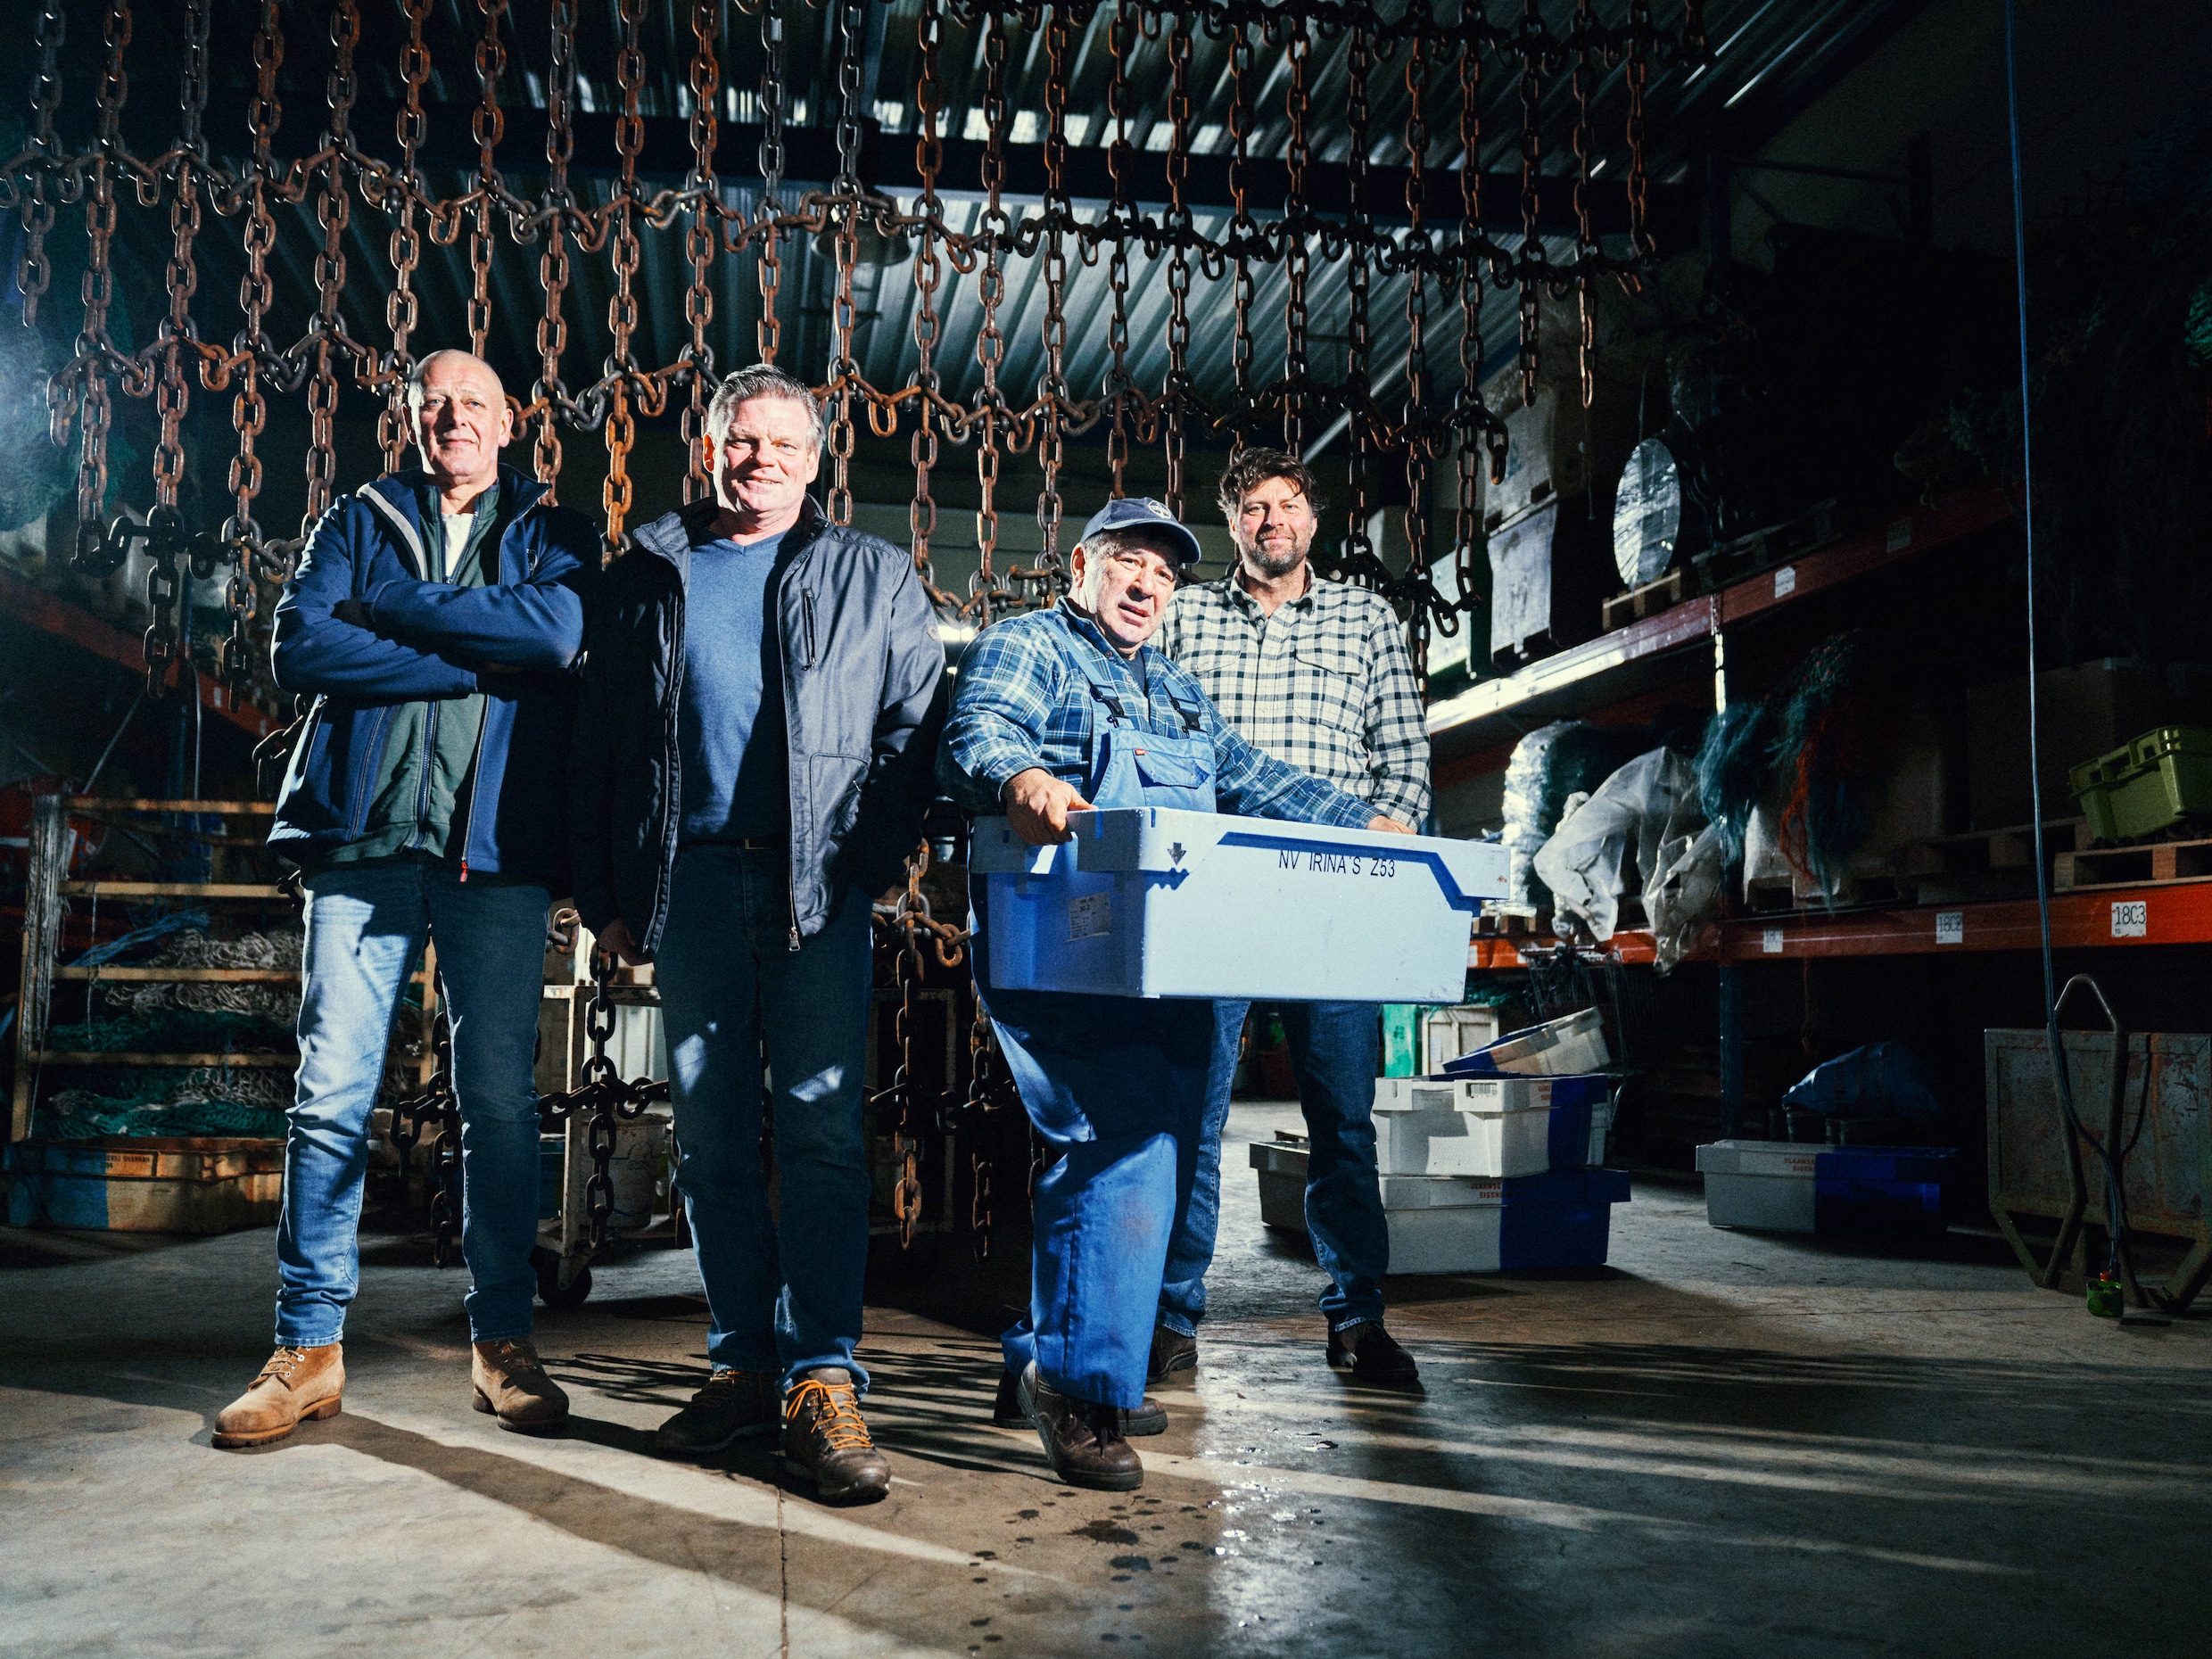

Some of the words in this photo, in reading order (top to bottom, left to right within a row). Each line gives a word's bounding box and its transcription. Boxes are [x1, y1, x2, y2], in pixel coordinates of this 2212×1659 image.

[1279, 850, 1300, 870] NV
[1309, 852, 1361, 875] IRINA'S
[1370, 858, 1395, 878] Z53
[1938, 915, 1961, 933] 18C2
[2115, 904, 2146, 925] 18C3
